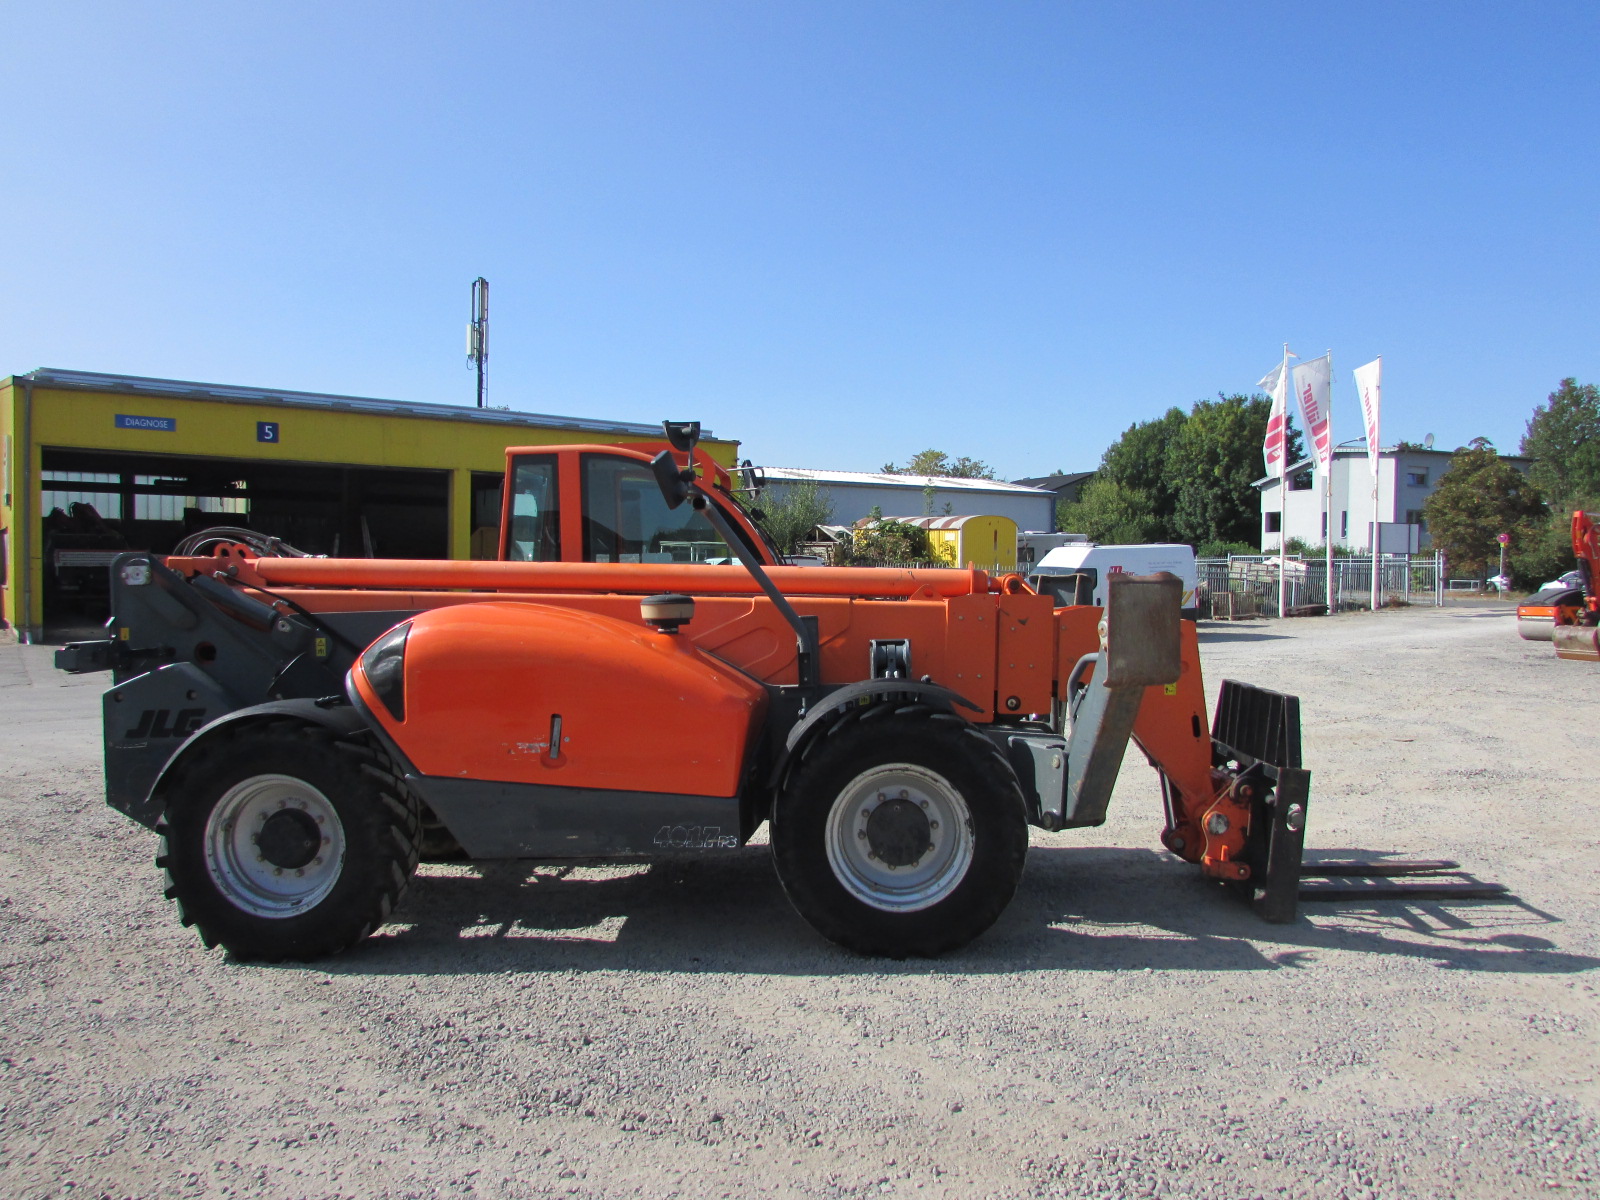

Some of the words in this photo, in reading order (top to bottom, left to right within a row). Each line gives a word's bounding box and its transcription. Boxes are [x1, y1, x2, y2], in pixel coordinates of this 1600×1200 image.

[125, 418, 168, 428] DIAGNOSE
[264, 426, 273, 439] 5
[125, 709, 206, 738] JLG
